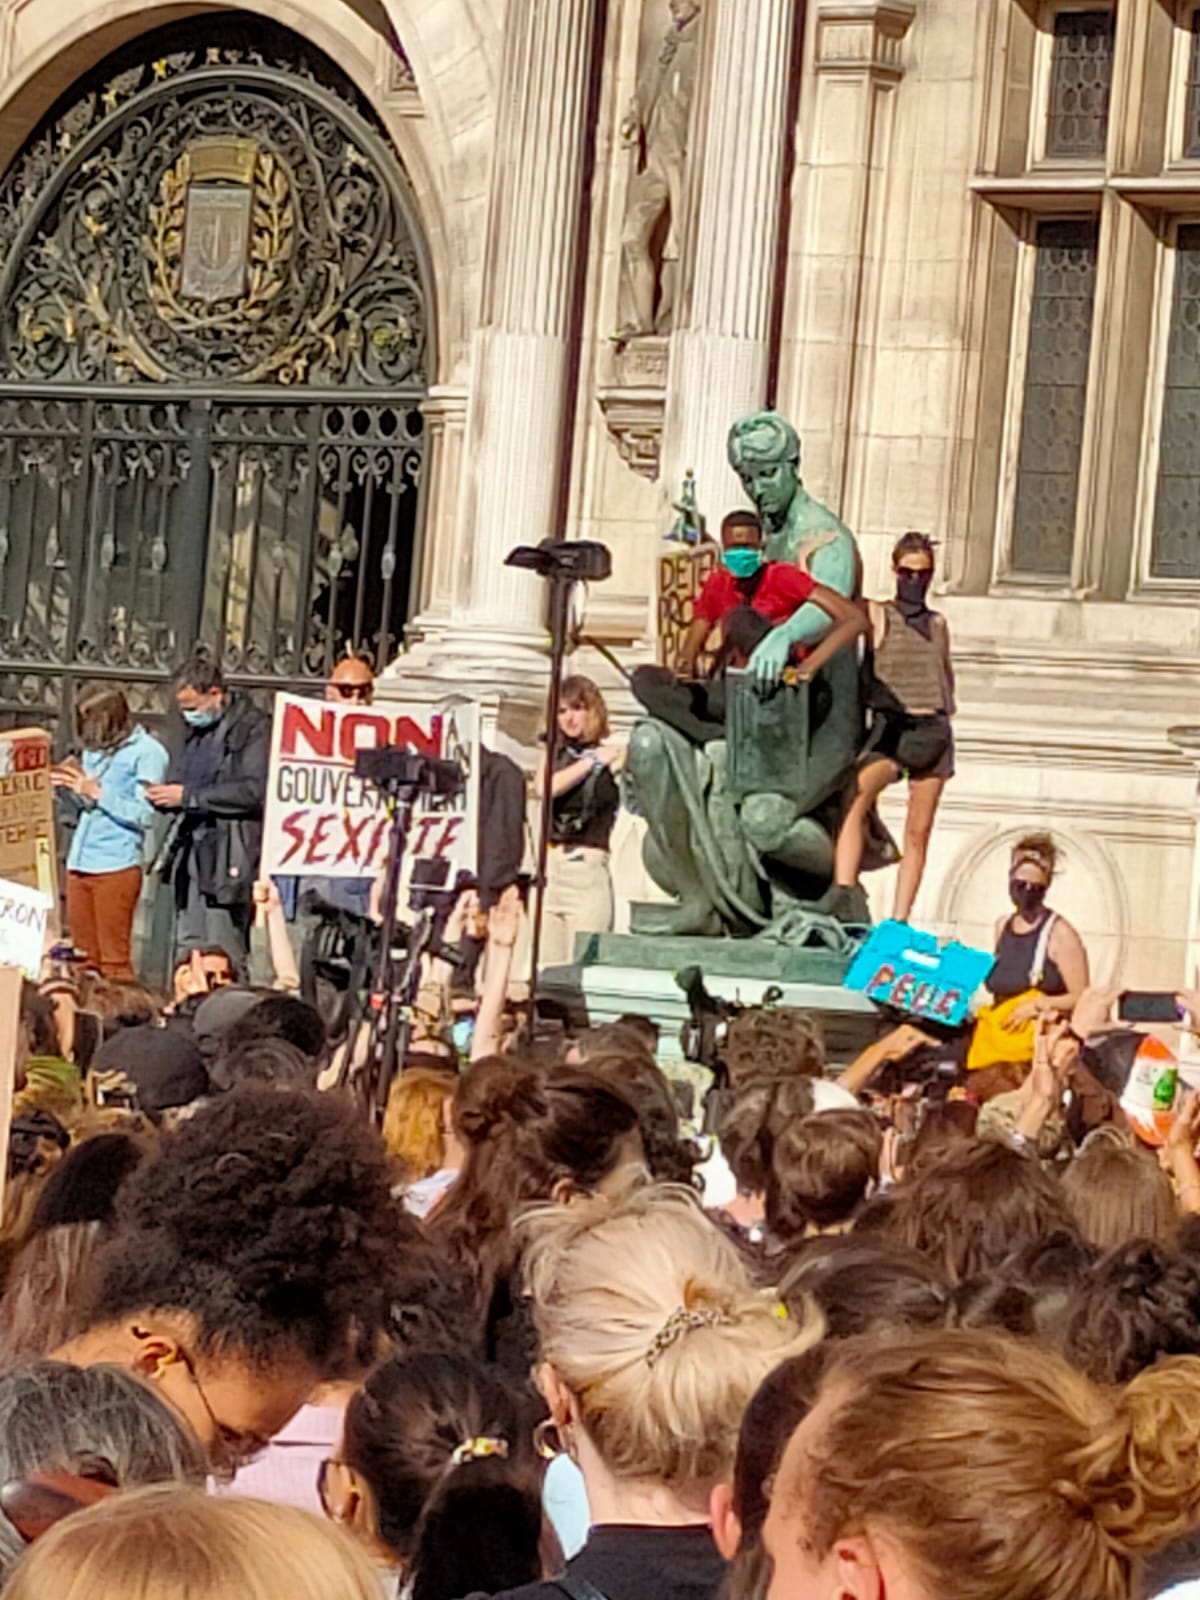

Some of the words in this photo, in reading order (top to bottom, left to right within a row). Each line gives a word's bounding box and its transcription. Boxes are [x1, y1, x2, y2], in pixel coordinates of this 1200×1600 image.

[280, 702, 443, 762] NON
[278, 808, 464, 869] SEXITE
[0, 895, 46, 932] RON
